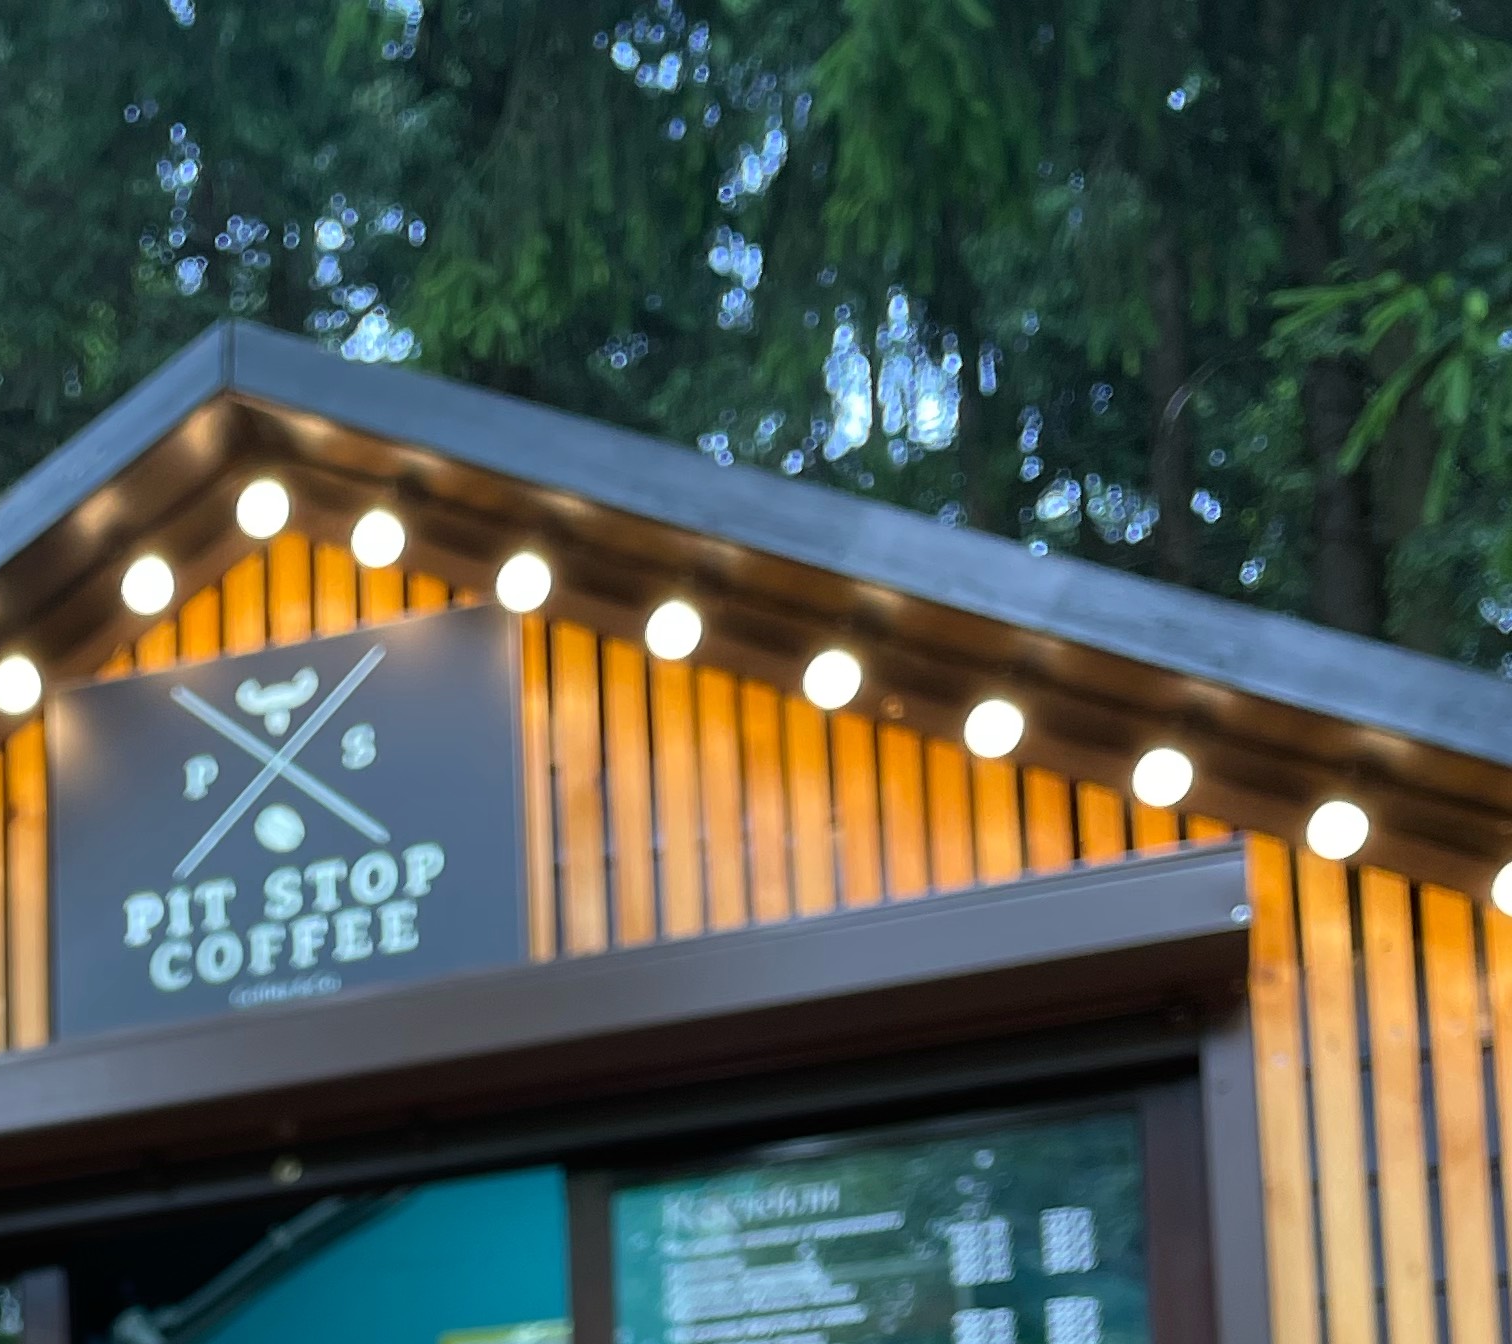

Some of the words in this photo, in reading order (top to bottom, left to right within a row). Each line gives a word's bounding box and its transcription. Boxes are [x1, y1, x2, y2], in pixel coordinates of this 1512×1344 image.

[183, 754, 219, 800] P
[123, 878, 237, 947] PIT
[264, 842, 445, 920] STOP
[149, 899, 419, 992] COFFEE
